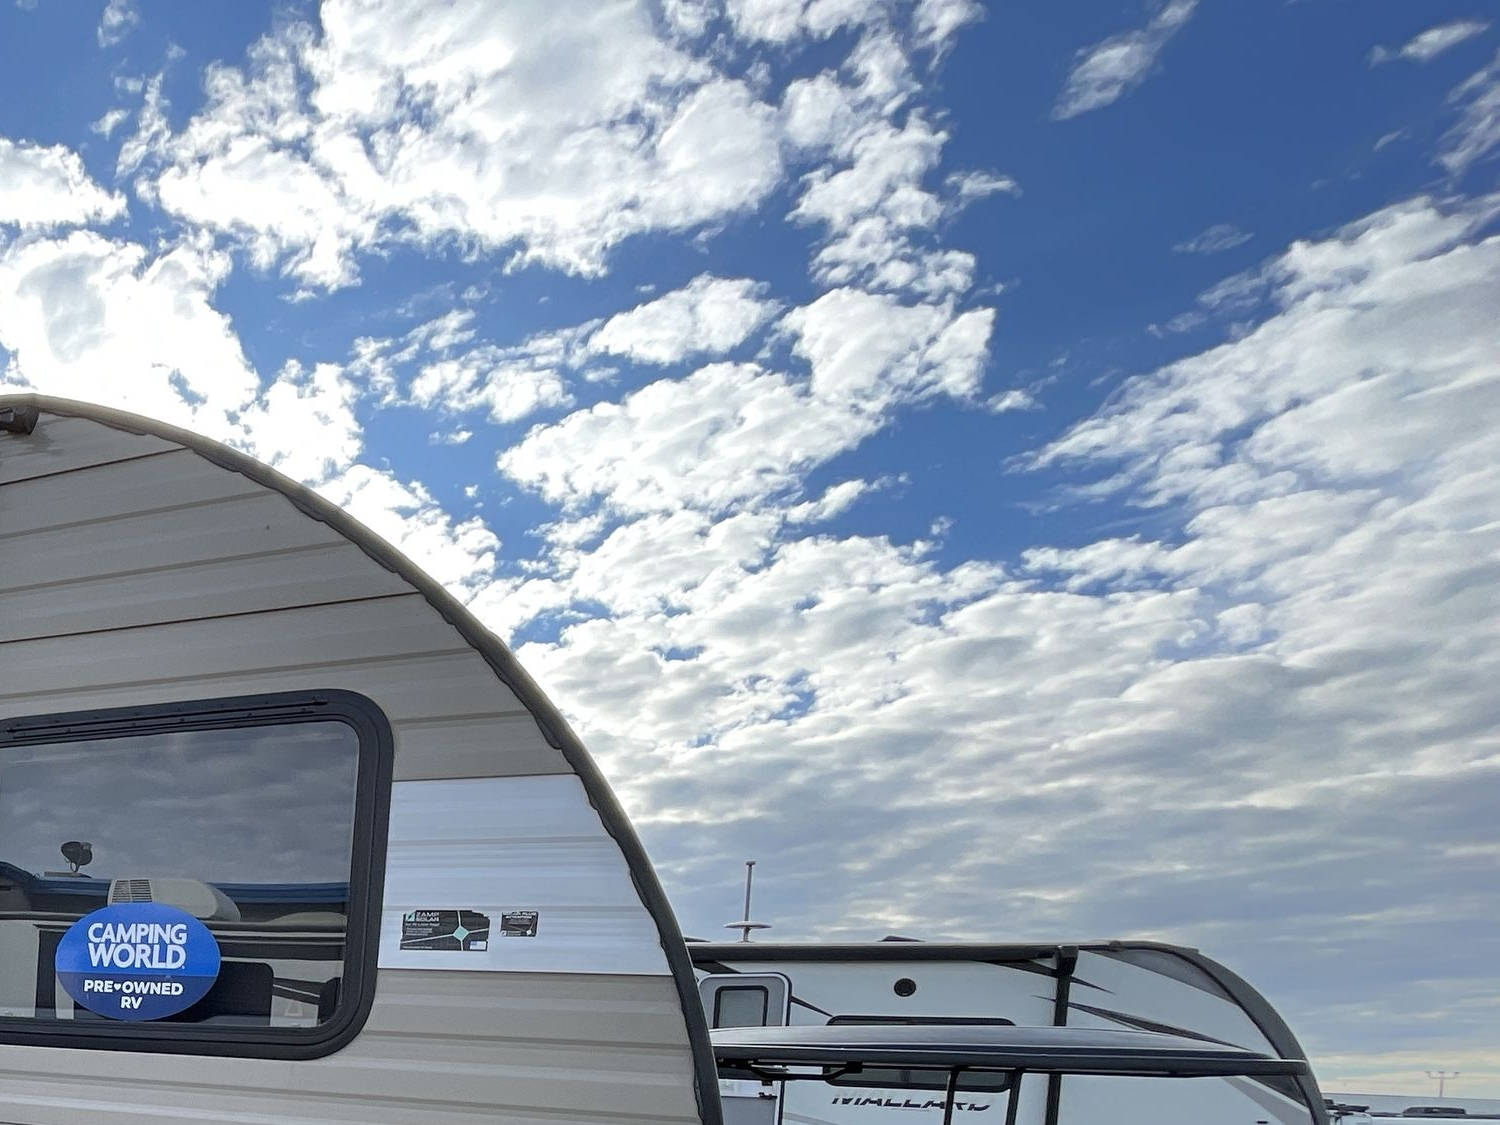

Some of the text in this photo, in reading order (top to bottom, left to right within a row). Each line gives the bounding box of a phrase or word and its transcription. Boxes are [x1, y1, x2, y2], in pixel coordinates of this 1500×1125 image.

[87, 922, 188, 945] CAMPING
[88, 942, 187, 970] WORLD
[120, 996, 143, 1010] RV
